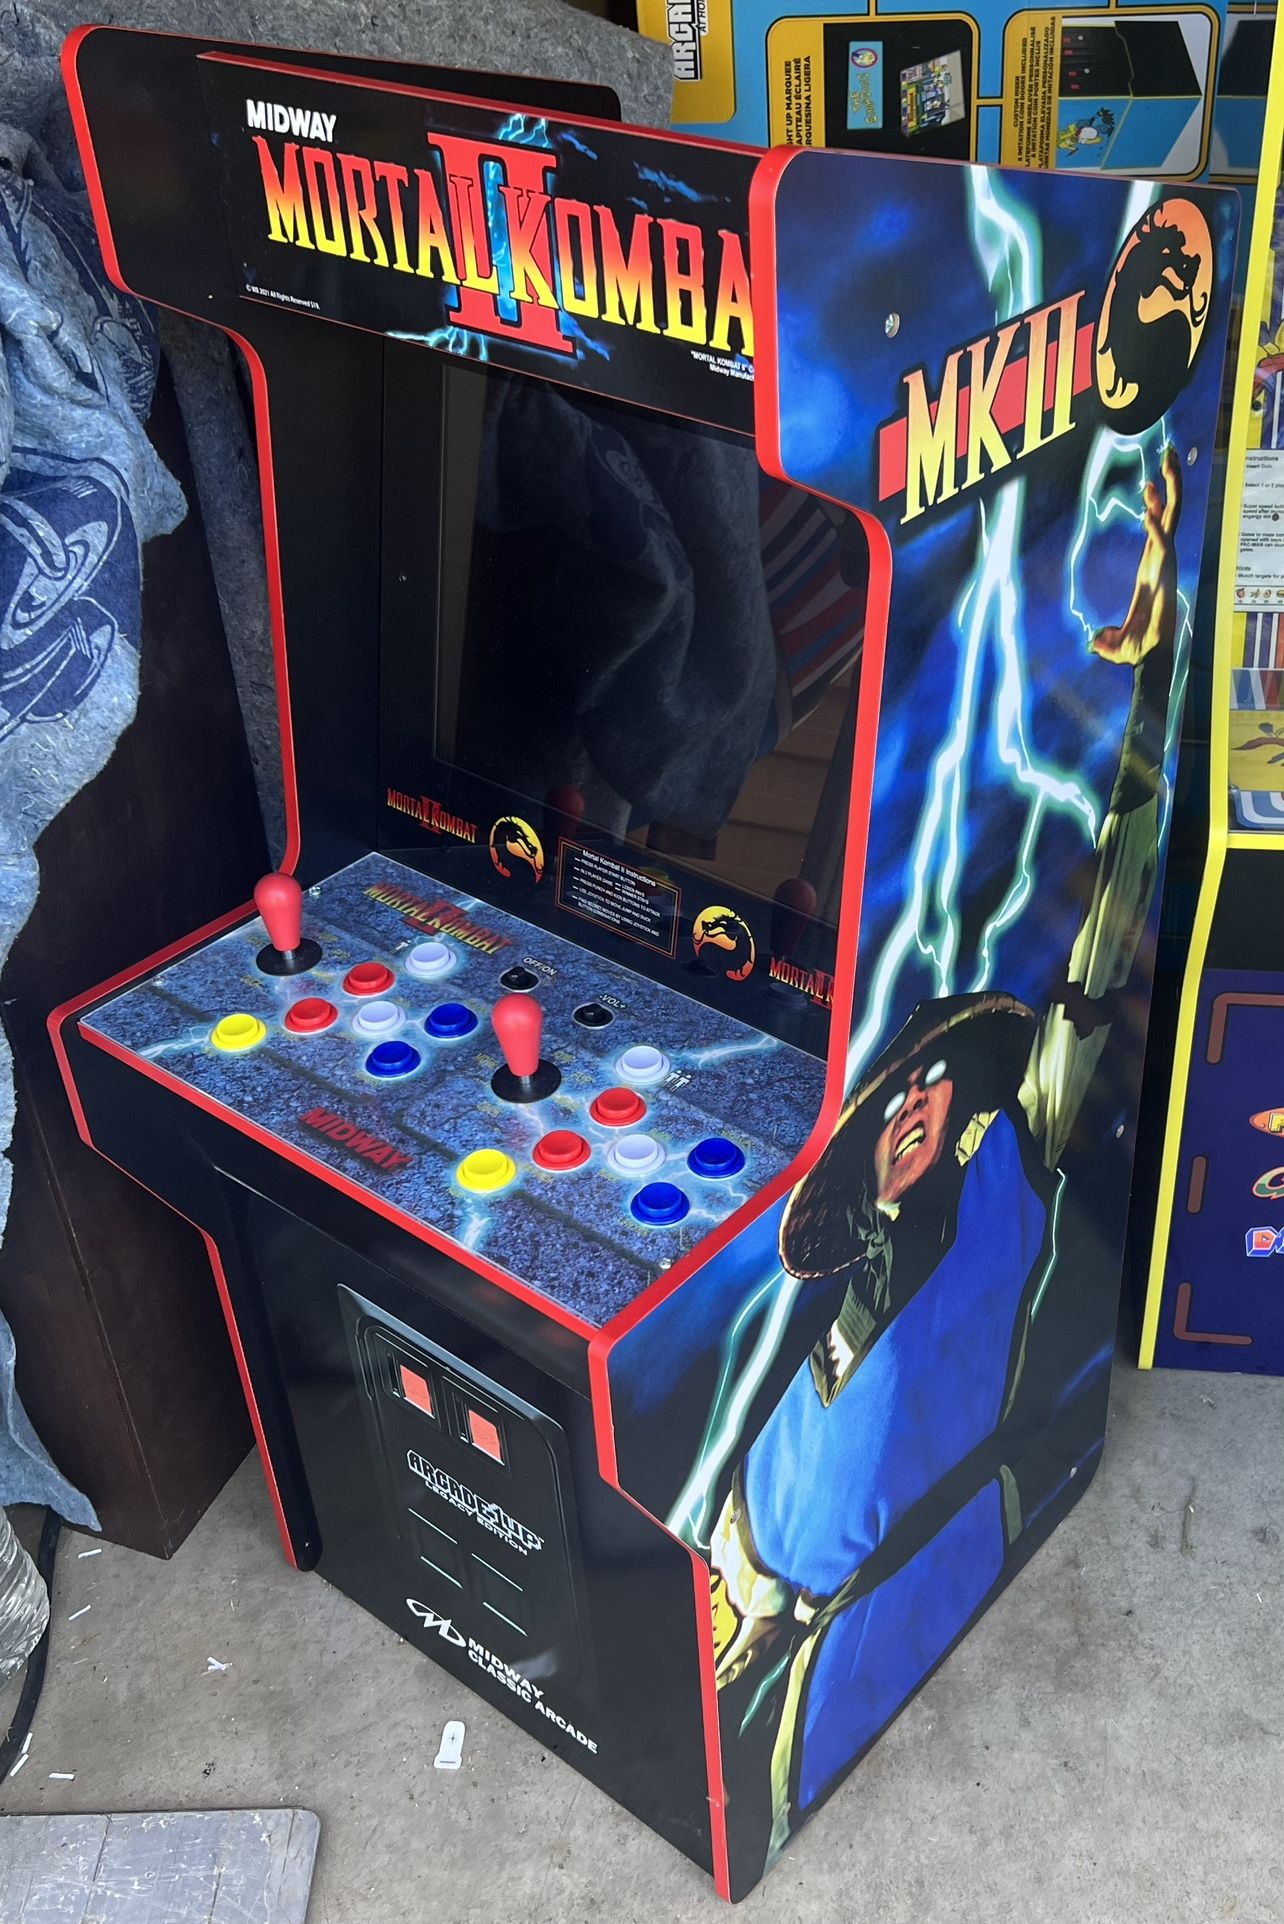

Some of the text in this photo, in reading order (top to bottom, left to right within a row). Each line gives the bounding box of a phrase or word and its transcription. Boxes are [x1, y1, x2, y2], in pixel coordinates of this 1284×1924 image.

[698, 0, 706, 18] HO
[667, 0, 700, 81] ARCA
[246, 99, 337, 143] MIDWAY
[784, 60, 793, 145] GHT UP MARQUEE
[792, 57, 803, 145] APITEAU ÉCLAIRÉ
[803, 55, 812, 146] RQUESINA LIGERA
[252, 135, 754, 357] MORTAL KOMBA
[709, 363, 729, 377] Midway
[729, 368, 755, 382] Manufact
[386, 787, 479, 845] MORTAL KOMBAT
[599, 856, 621, 872] Kombat
[625, 867, 656, 888] Instructions
[523, 957, 558, 976] OFF/ON
[768, 956, 824, 999] MORTAL
[299, 1106, 414, 1170] MIDWAY
[425, 1480, 473, 1517] LEGACY
[476, 1515, 528, 1556] EDITION
[468, 1637, 544, 1700] MIDWAY
[467, 1649, 598, 1755] CLASSIC ARCADE
